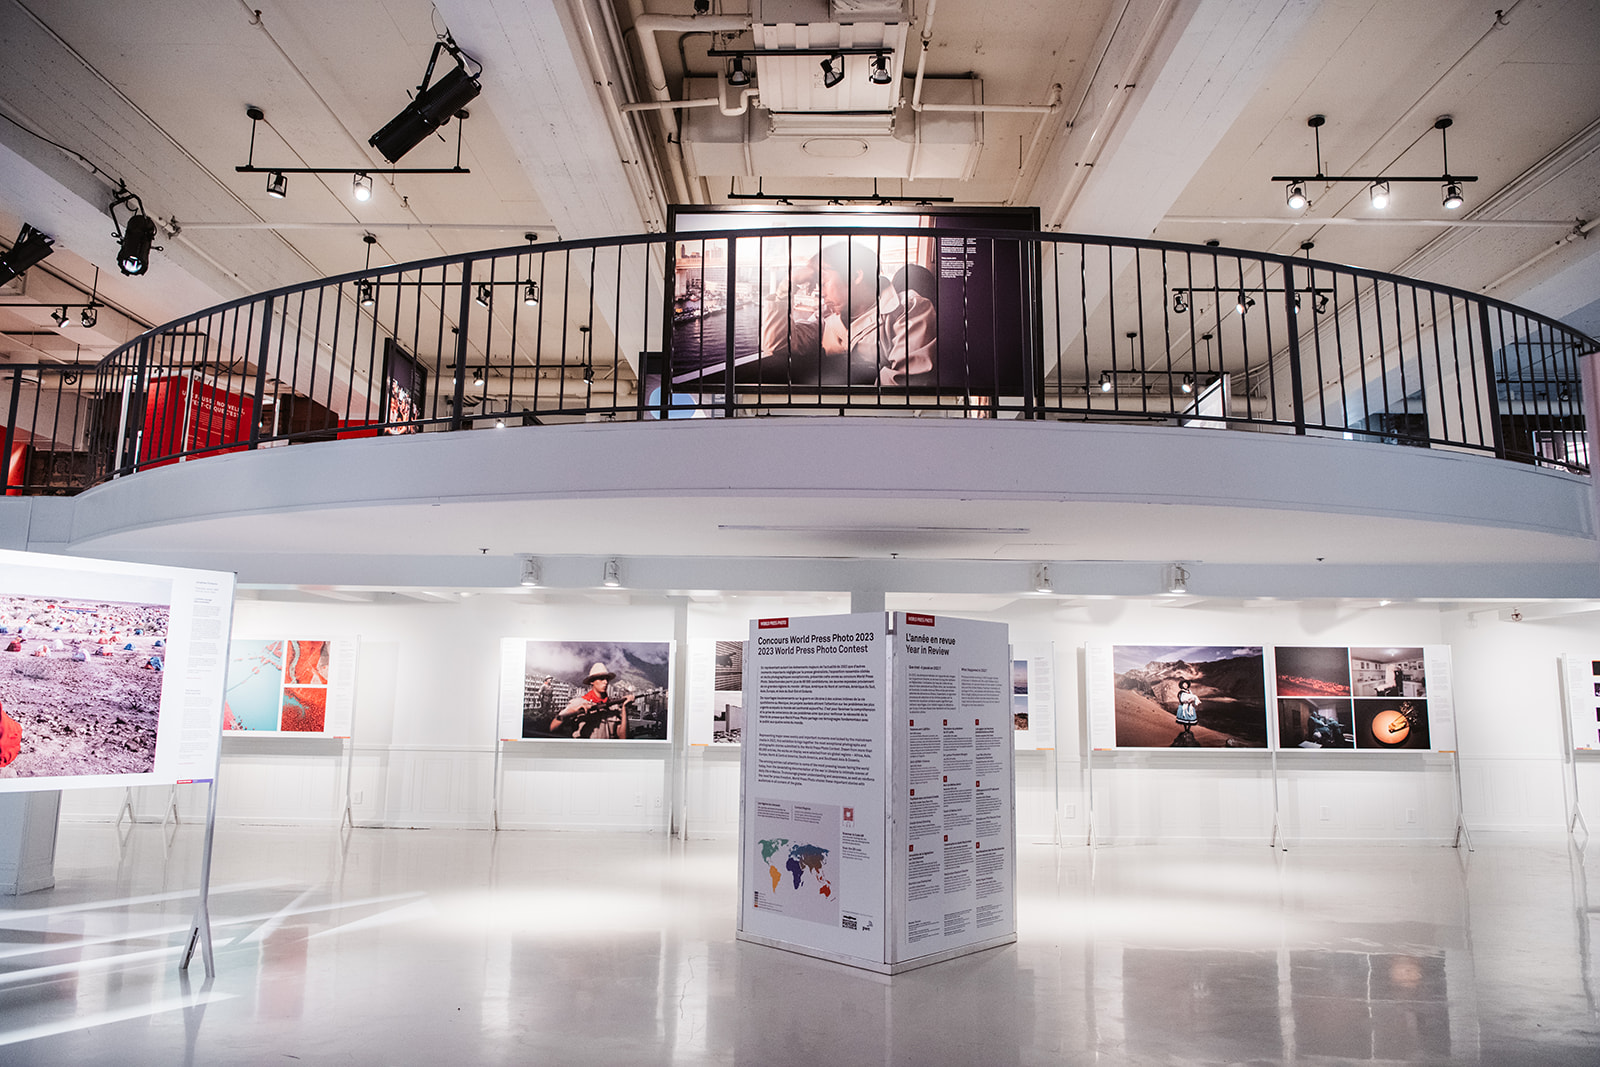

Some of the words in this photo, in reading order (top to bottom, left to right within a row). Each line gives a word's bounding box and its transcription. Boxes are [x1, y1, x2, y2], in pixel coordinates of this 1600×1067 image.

[758, 636, 789, 645] Concours
[789, 634, 810, 644] World
[811, 633, 831, 643] Press
[832, 632, 854, 642] Photo
[855, 632, 874, 642] 2023
[906, 633, 929, 643] L'année
[939, 637, 955, 645] revue
[758, 647, 774, 655] 2023
[775, 646, 795, 655] World
[795, 645, 815, 655] Press
[816, 644, 838, 654] Photo
[838, 644, 868, 654] Contest
[906, 644, 920, 654] Year
[920, 645, 927, 654] in
[927, 645, 950, 656] Review
